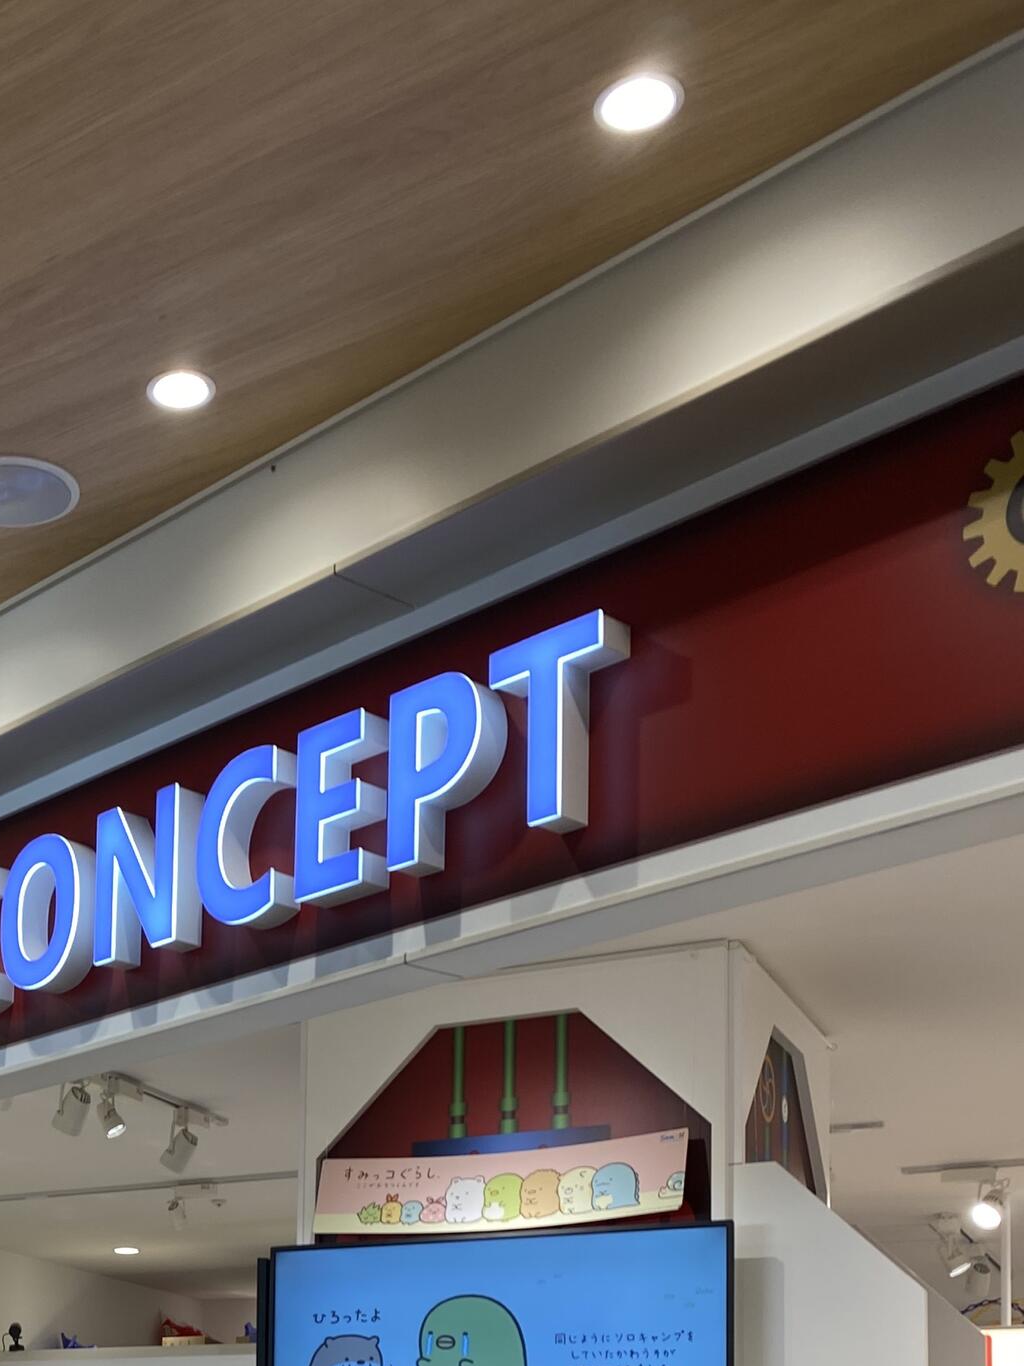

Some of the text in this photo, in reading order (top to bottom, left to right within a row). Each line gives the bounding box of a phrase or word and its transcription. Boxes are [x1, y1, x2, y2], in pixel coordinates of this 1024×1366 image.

[343, 1165, 437, 1182] すみっコぐらし
[312, 1307, 381, 1325] ひろったよ
[554, 1329, 694, 1345] 同じようにソロキャンプを
